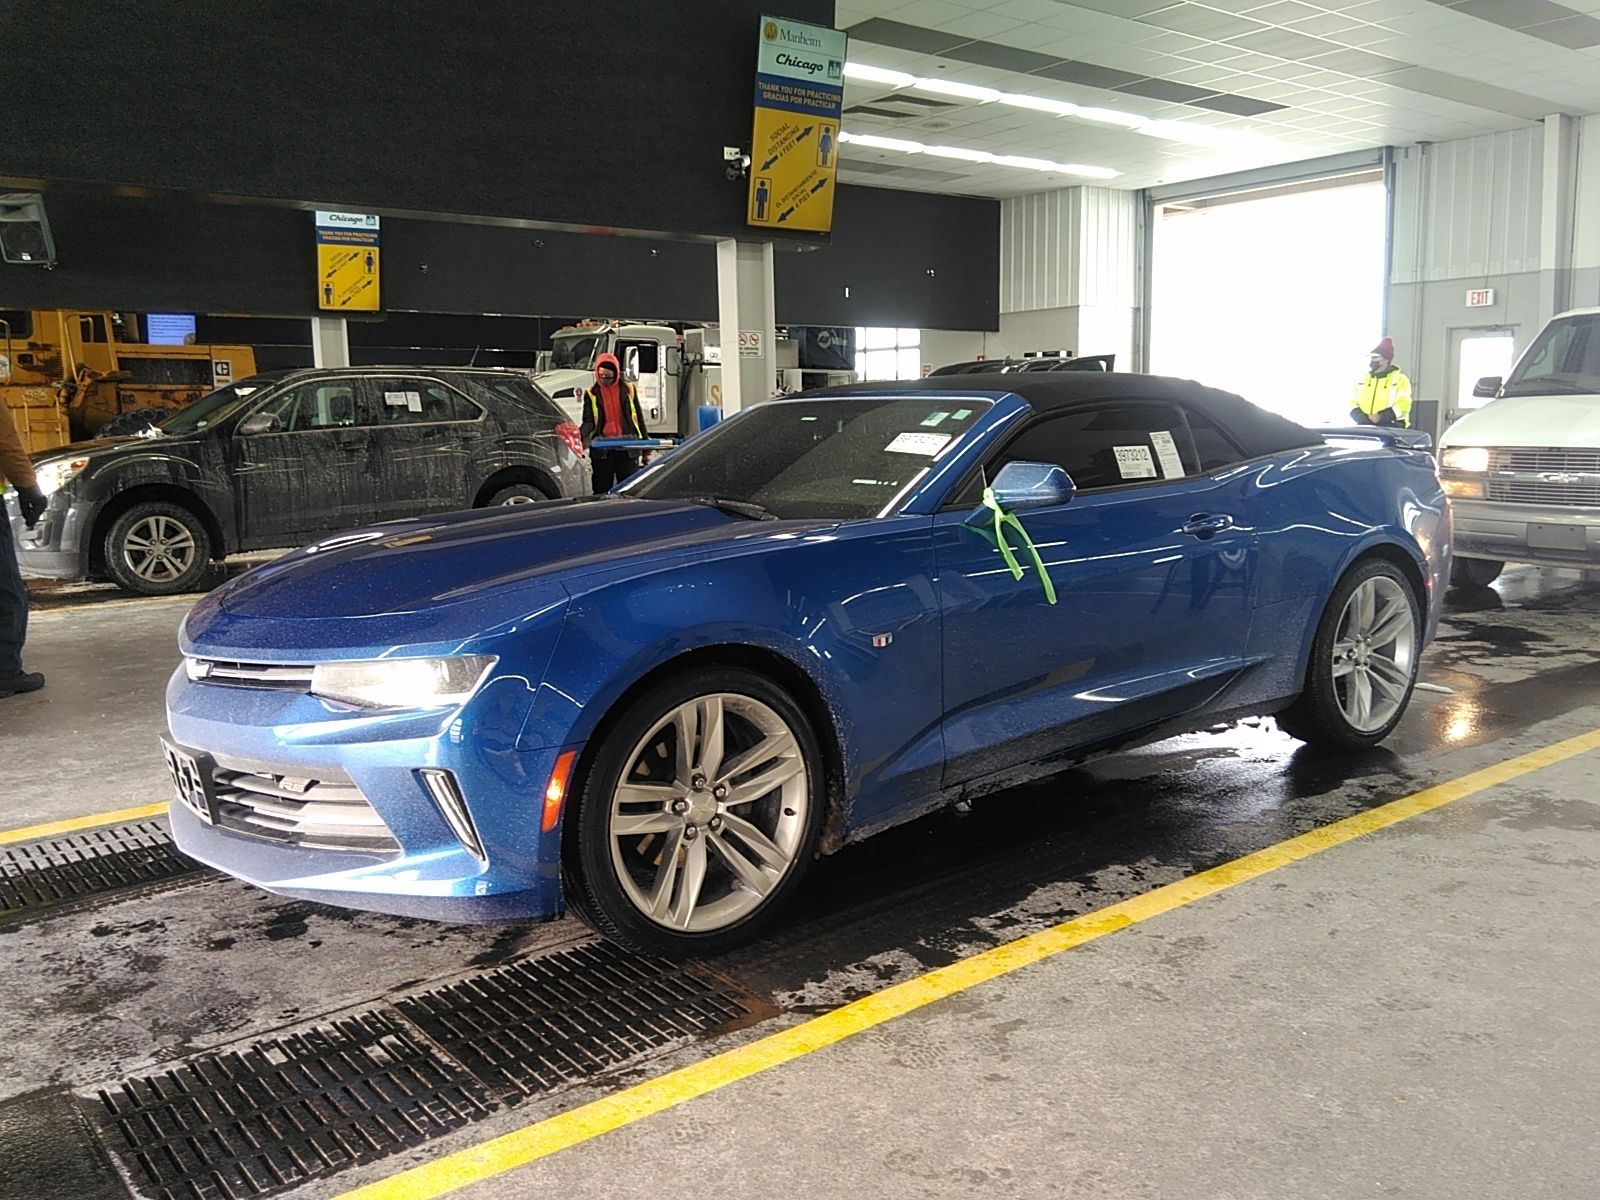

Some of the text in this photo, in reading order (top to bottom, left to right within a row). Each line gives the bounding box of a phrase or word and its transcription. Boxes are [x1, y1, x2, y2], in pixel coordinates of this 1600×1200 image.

[780, 28, 822, 47] Manheim
[776, 53, 824, 74] Chicago
[758, 82, 841, 102] THANK YOU FOR PRACTICING
[763, 91, 789, 103] GRACIAS
[768, 126, 800, 155] DISTANCING
[770, 123, 791, 142] SOCIAL
[783, 140, 796, 154] FEET
[329, 214, 364, 224] Chicago
[1471, 291, 1490, 305] EXIT
[1116, 448, 1148, 462] 3973212
